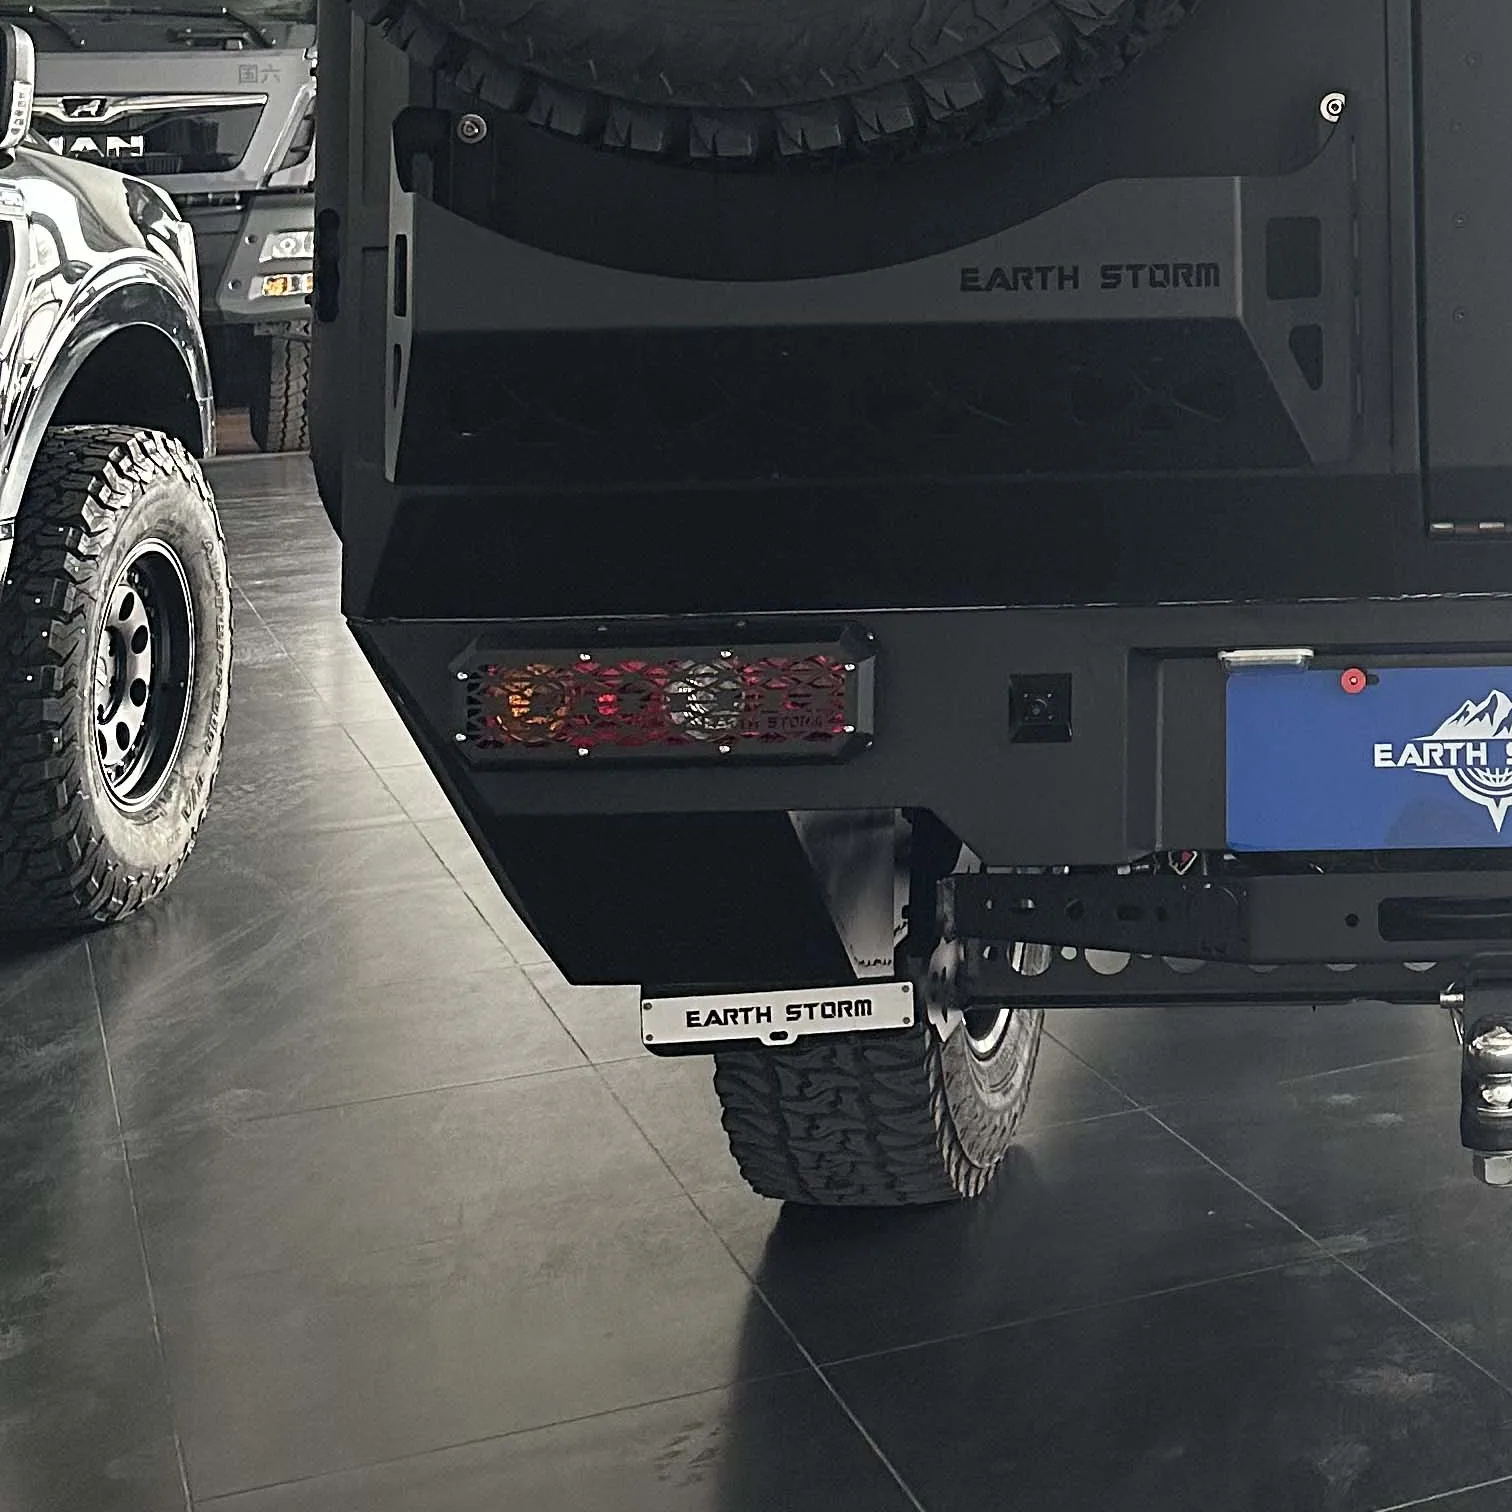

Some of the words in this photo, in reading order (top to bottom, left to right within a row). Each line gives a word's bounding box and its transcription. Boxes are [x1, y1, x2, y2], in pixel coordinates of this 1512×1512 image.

[238, 63, 281, 85] 国六
[959, 264, 1080, 292] EARTH
[1100, 261, 1220, 289] STORM
[1373, 741, 1488, 768] EARTH
[685, 1005, 773, 1028] EARTH
[785, 998, 873, 1022] STORM
